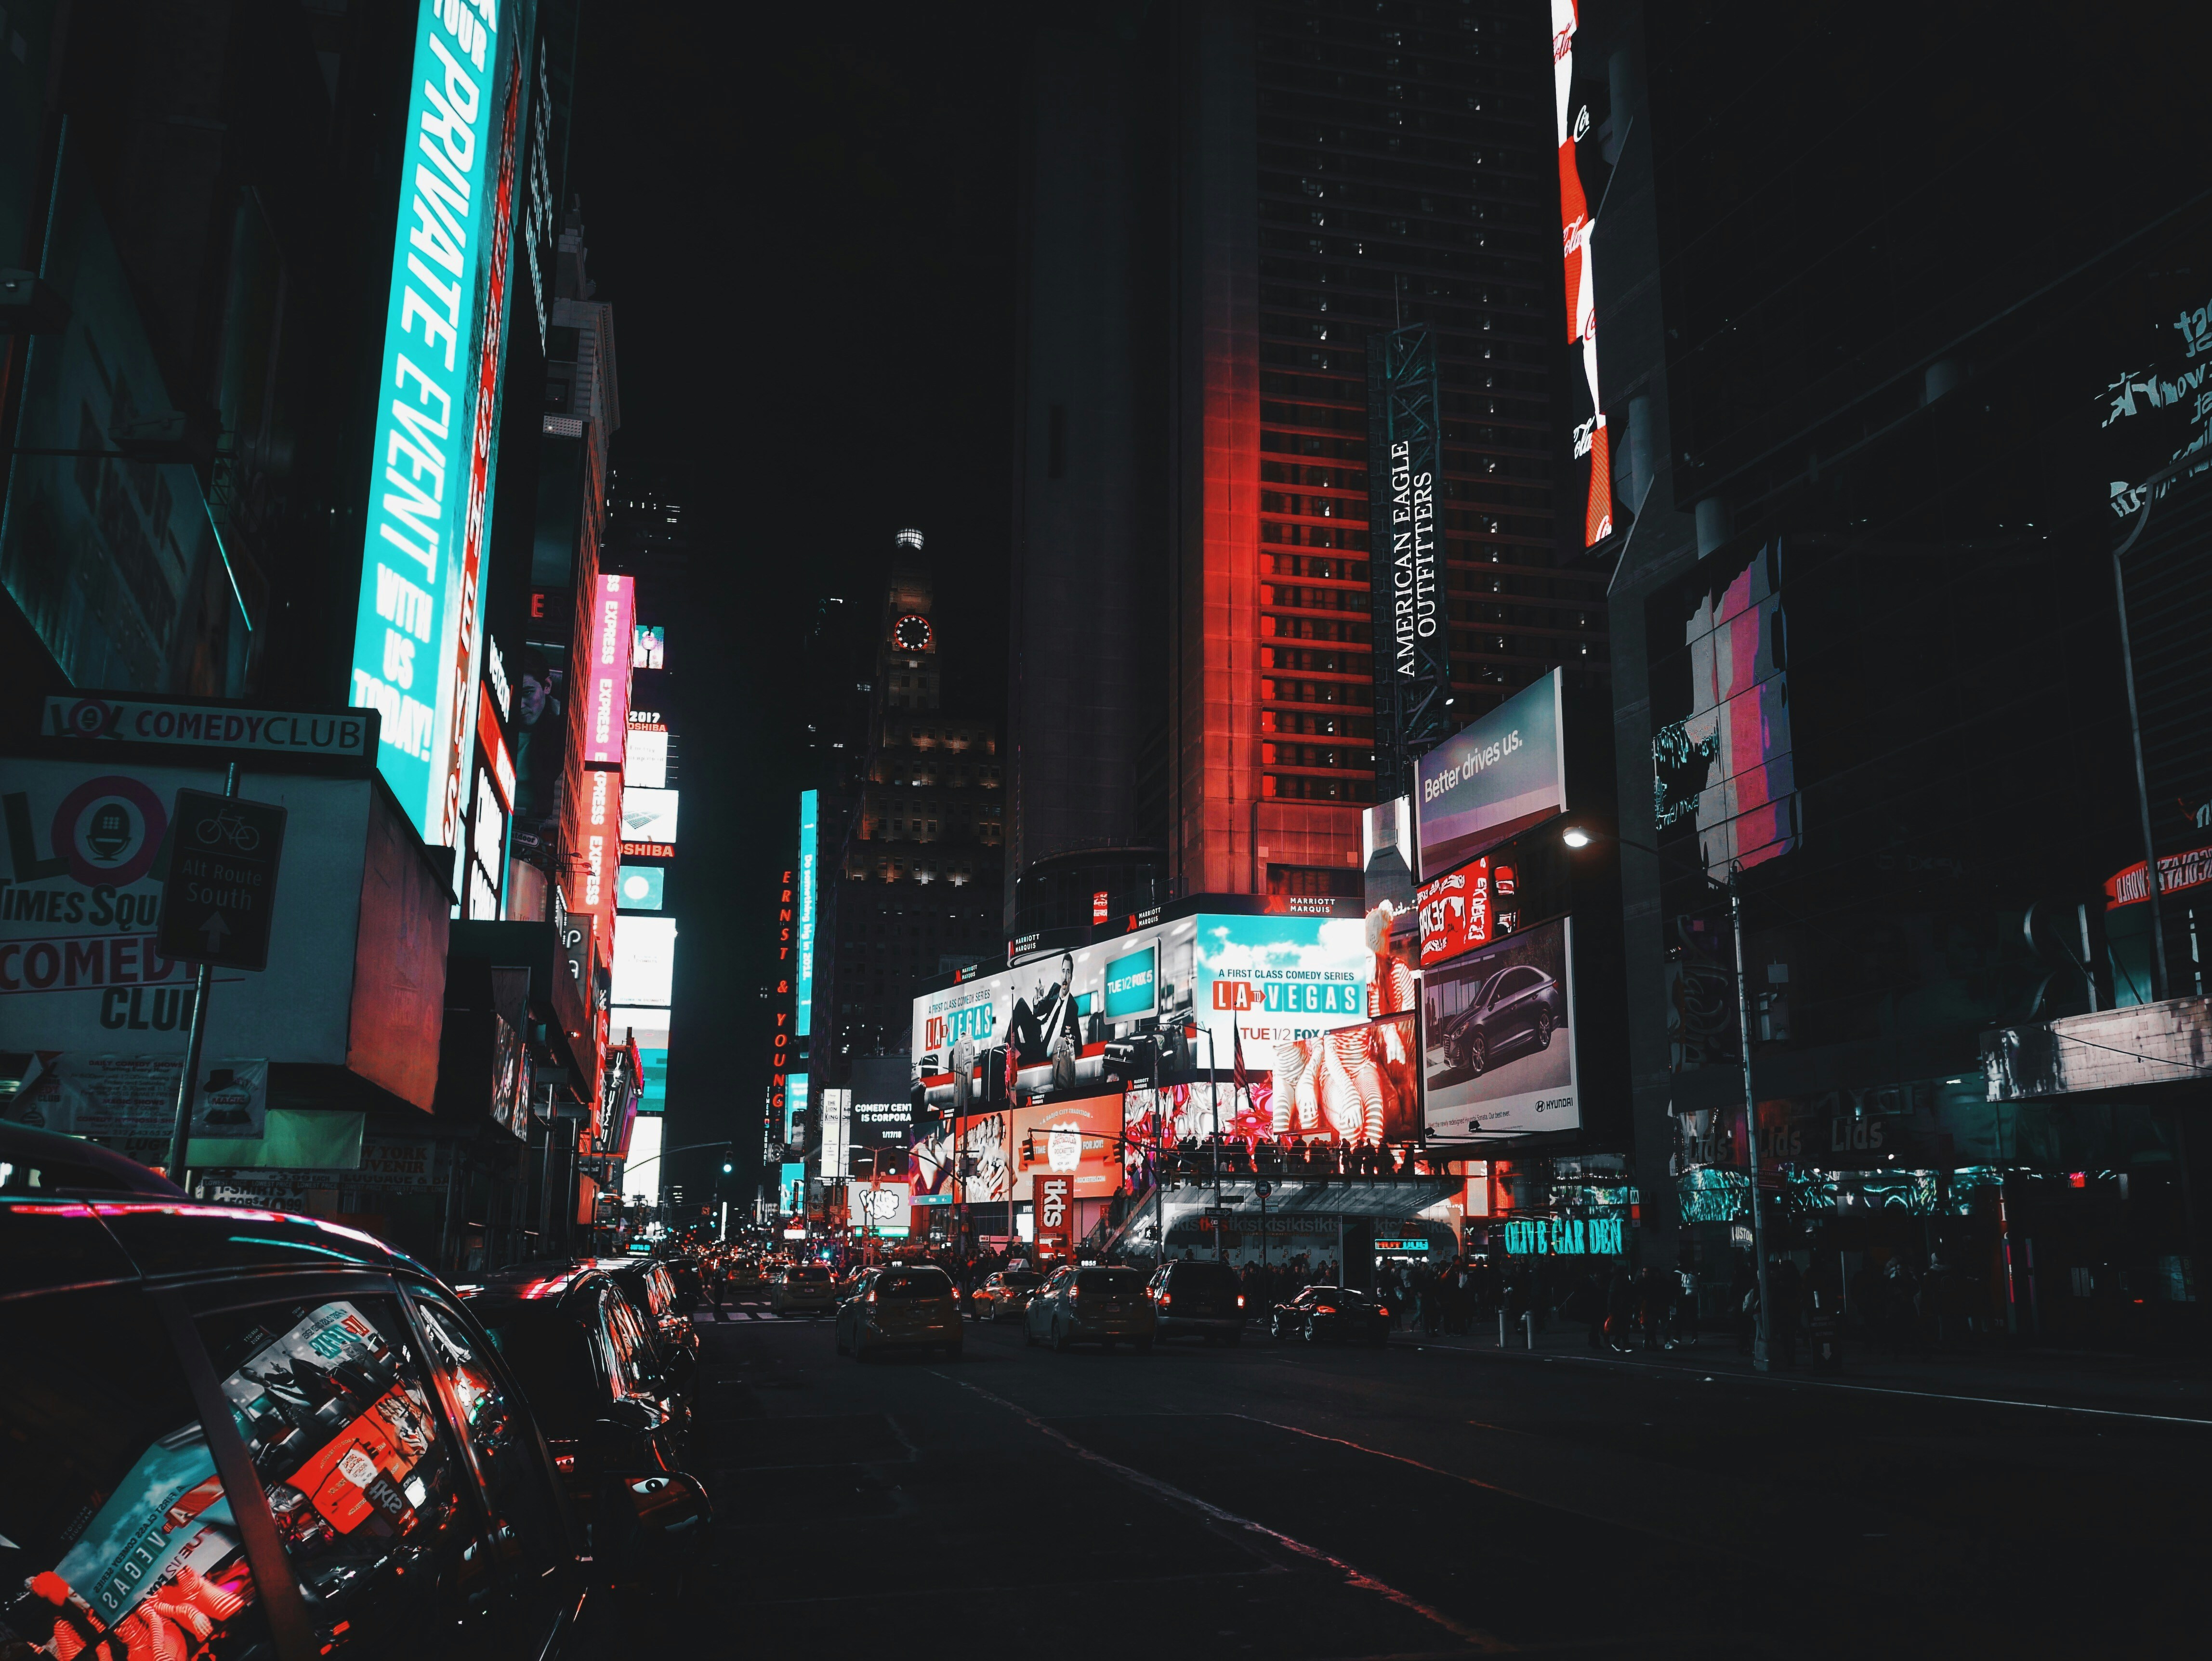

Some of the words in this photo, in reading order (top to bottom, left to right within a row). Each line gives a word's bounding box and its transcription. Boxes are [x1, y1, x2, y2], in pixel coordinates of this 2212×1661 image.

[540, 36, 552, 141] Best
[400, 32, 480, 371] PRIVATE
[530, 141, 542, 243] Best
[380, 353, 451, 584] EVENT
[1391, 441, 1411, 525] EAGLE
[1414, 472, 1437, 637] OUTFITTERS
[376, 563, 434, 644] WITH
[1395, 530, 1415, 677] AMERICAN
[602, 600, 619, 665] EXPRESS
[383, 628, 416, 690] US
[354, 668, 434, 763] TODAY!
[595, 678, 612, 744] EXPRESS
[629, 712, 660, 723] 2017
[1424, 766, 1460, 803] Better
[1462, 744, 1501, 779] drives
[1502, 728, 1523, 763] us.
[182, 859, 206, 878] Alt
[212, 864, 263, 886] Route
[585, 836, 603, 906] EXPRESS
[803, 854, 813, 868] Do
[186, 883, 252, 910] South
[802, 870, 813, 923] something
[1290, 897, 1335, 906] MARRIOTT
[779, 871, 792, 960] ERNST
[1138, 907, 1161, 919] MARRIOTT
[1138, 916, 1159, 927] MARQUIS
[802, 923, 812, 940] big
[1015, 934, 1040, 945] MARRIOTT
[802, 941, 812, 951] in
[1015, 943, 1037, 953] MARQUIS
[961, 971, 975, 980] MARQUIS
[962, 964, 977, 973] MARRIOTT
[1107, 979, 1121, 994] TUE
[1132, 971, 1146, 988] FOX
[1146, 969, 1153, 983] 5
[1228, 969, 1252, 978] FIRST
[1255, 970, 1283, 978] CLASS
[1286, 971, 1321, 980] COMEDY
[1324, 972, 1354, 980] SERIES
[777, 980, 789, 993] &
[1218, 983, 1248, 1008] LA
[1253, 991, 1261, 1002] TO
[1267, 985, 1356, 1011] VEGAS
[928, 1005, 932, 1015] A
[932, 1002, 943, 1014] FIRST
[944, 999, 957, 1011] CLASS
[957, 993, 975, 1007] COMEDY
[975, 989, 990, 1002] SERIES
[927, 1018, 941, 1048] LA
[948, 1005, 991, 1043] VEGAS
[1240, 1028, 1270, 1040] TUE
[1273, 1028, 1290, 1041] 1/2
[1294, 1029, 1320, 1041] FOX
[772, 1013, 787, 1108] YOUNG
[825, 1113, 839, 1121] KING
[855, 1104, 890, 1113] COMEDY
[1046, 1111, 1058, 1121] RADIO
[1069, 1108, 1091, 1119] TRADITION
[1546, 1098, 1574, 1109] HYUNDAI
[861, 1114, 870, 1122] IS
[1082, 1141, 1093, 1149] FOR
[1093, 1139, 1104, 1149] JOY!
[1689, 1131, 1727, 1164] Lids
[1759, 1124, 1802, 1159] Lids
[1831, 1117, 1883, 1152] Lids
[381, 1146, 428, 1160] YORK
[1043, 1179, 1067, 1228] tkts
[1505, 1220, 1548, 1254] OLIVE
[1552, 1218, 1623, 1254] GARDEN
